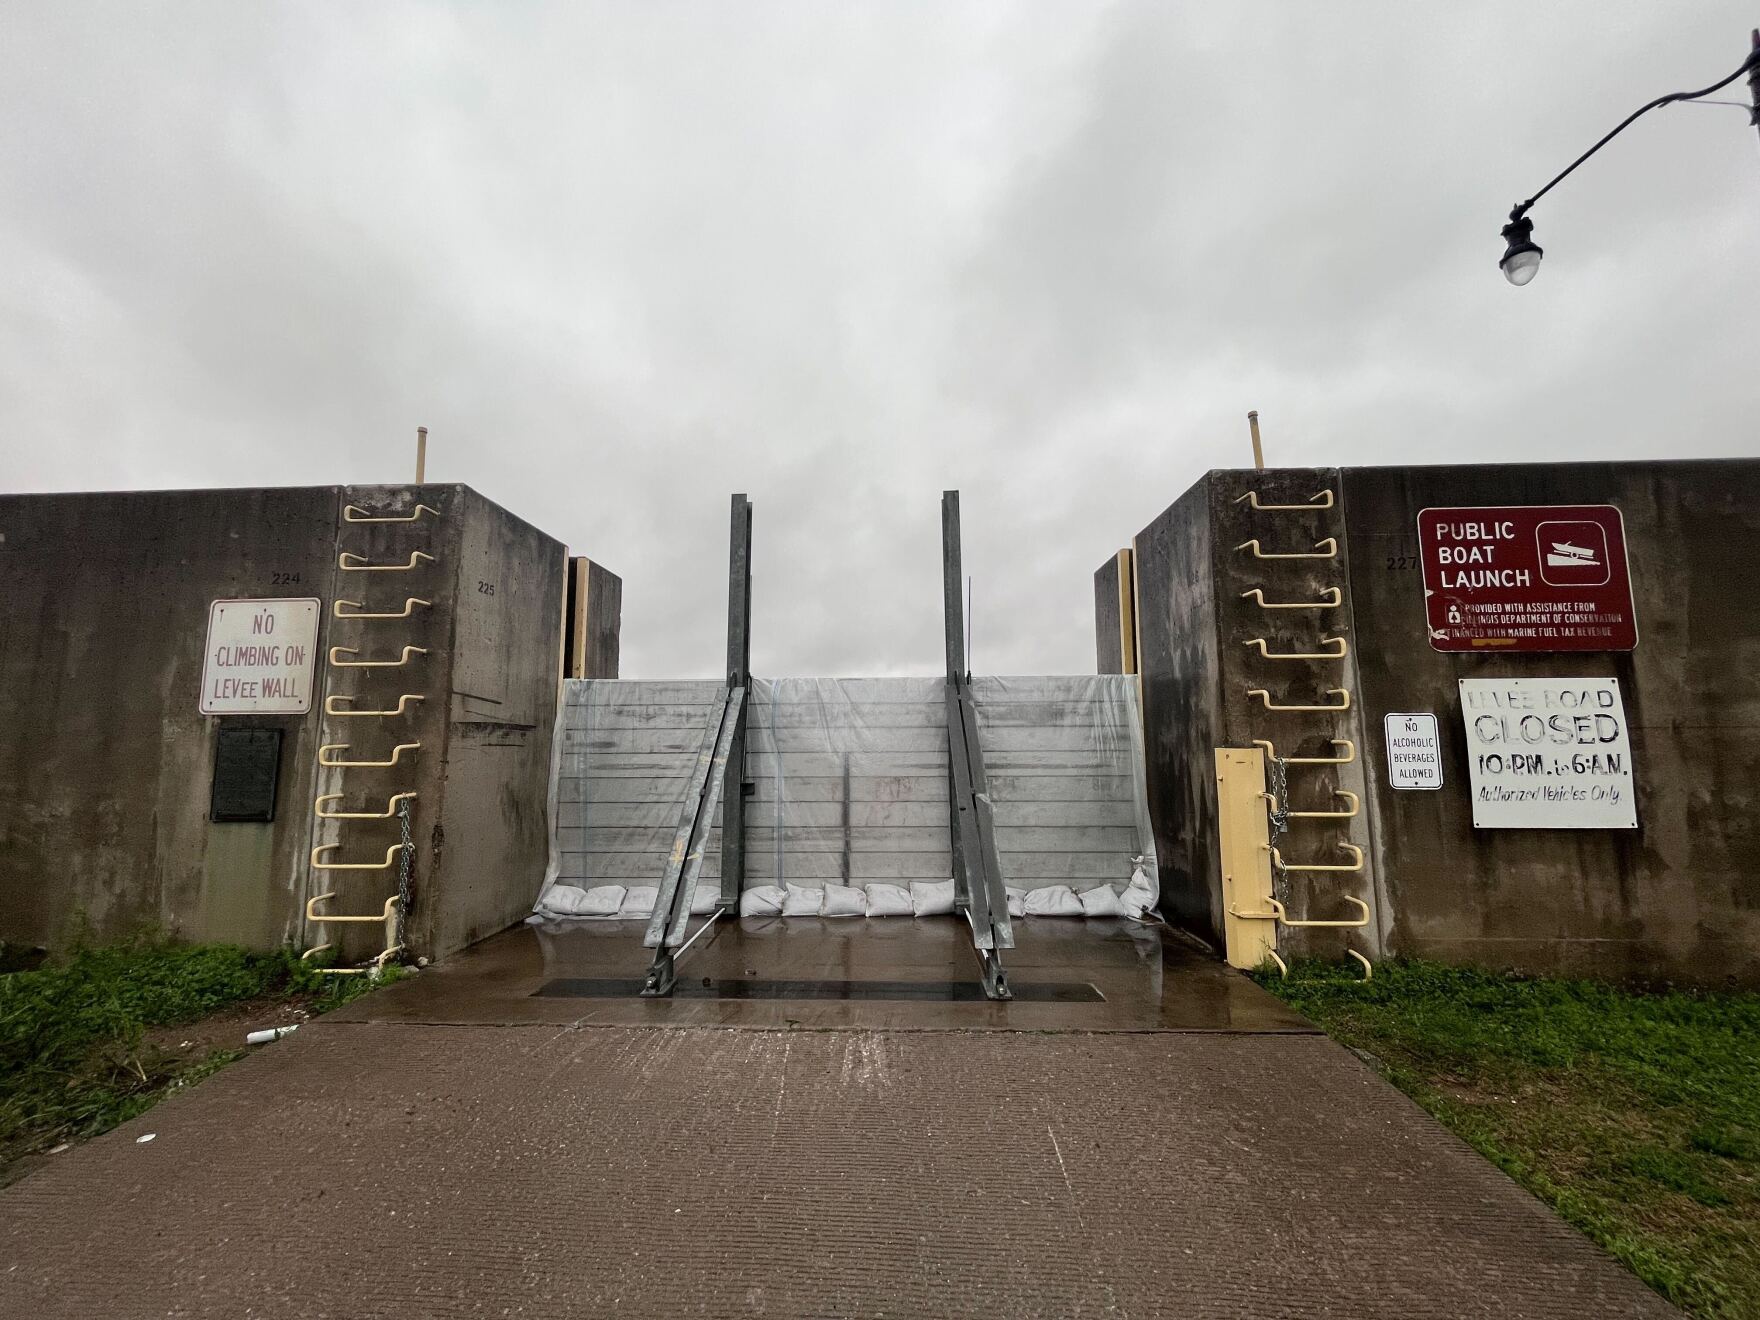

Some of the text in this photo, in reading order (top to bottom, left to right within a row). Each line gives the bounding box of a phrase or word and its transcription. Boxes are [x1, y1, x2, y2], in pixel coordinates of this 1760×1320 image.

[1436, 521, 1515, 541] PUBLIC
[1438, 545, 1495, 564] BOAT
[1386, 556, 1417, 571] 227
[271, 572, 300, 586] 224
[1440, 569, 1530, 589] LAUNCH
[478, 580, 495, 597] 225
[1464, 602, 1596, 613] PROVIDED WITH ASSISTANCE FROM
[252, 614, 275, 635] NO
[1500, 613, 1551, 624] DEPARTMENT
[1553, 613, 1562, 624] OF
[1486, 627, 1506, 638] WITH
[1507, 627, 1537, 638] MARINE
[1538, 626, 1558, 637] FUEL
[1560, 626, 1575, 637] TAX
[216, 646, 304, 667] CLIMBING ON
[262, 677, 299, 699] WALL
[1543, 689, 1614, 709] ROAD
[1405, 722, 1418, 732] NO
[1474, 713, 1619, 745] CLOSED
[1393, 737, 1434, 748] ALCOHOLIC
[1394, 753, 1435, 763] BEVERAGES
[1399, 768, 1434, 779] ALLOWED
[1477, 785, 1541, 802] Authorized
